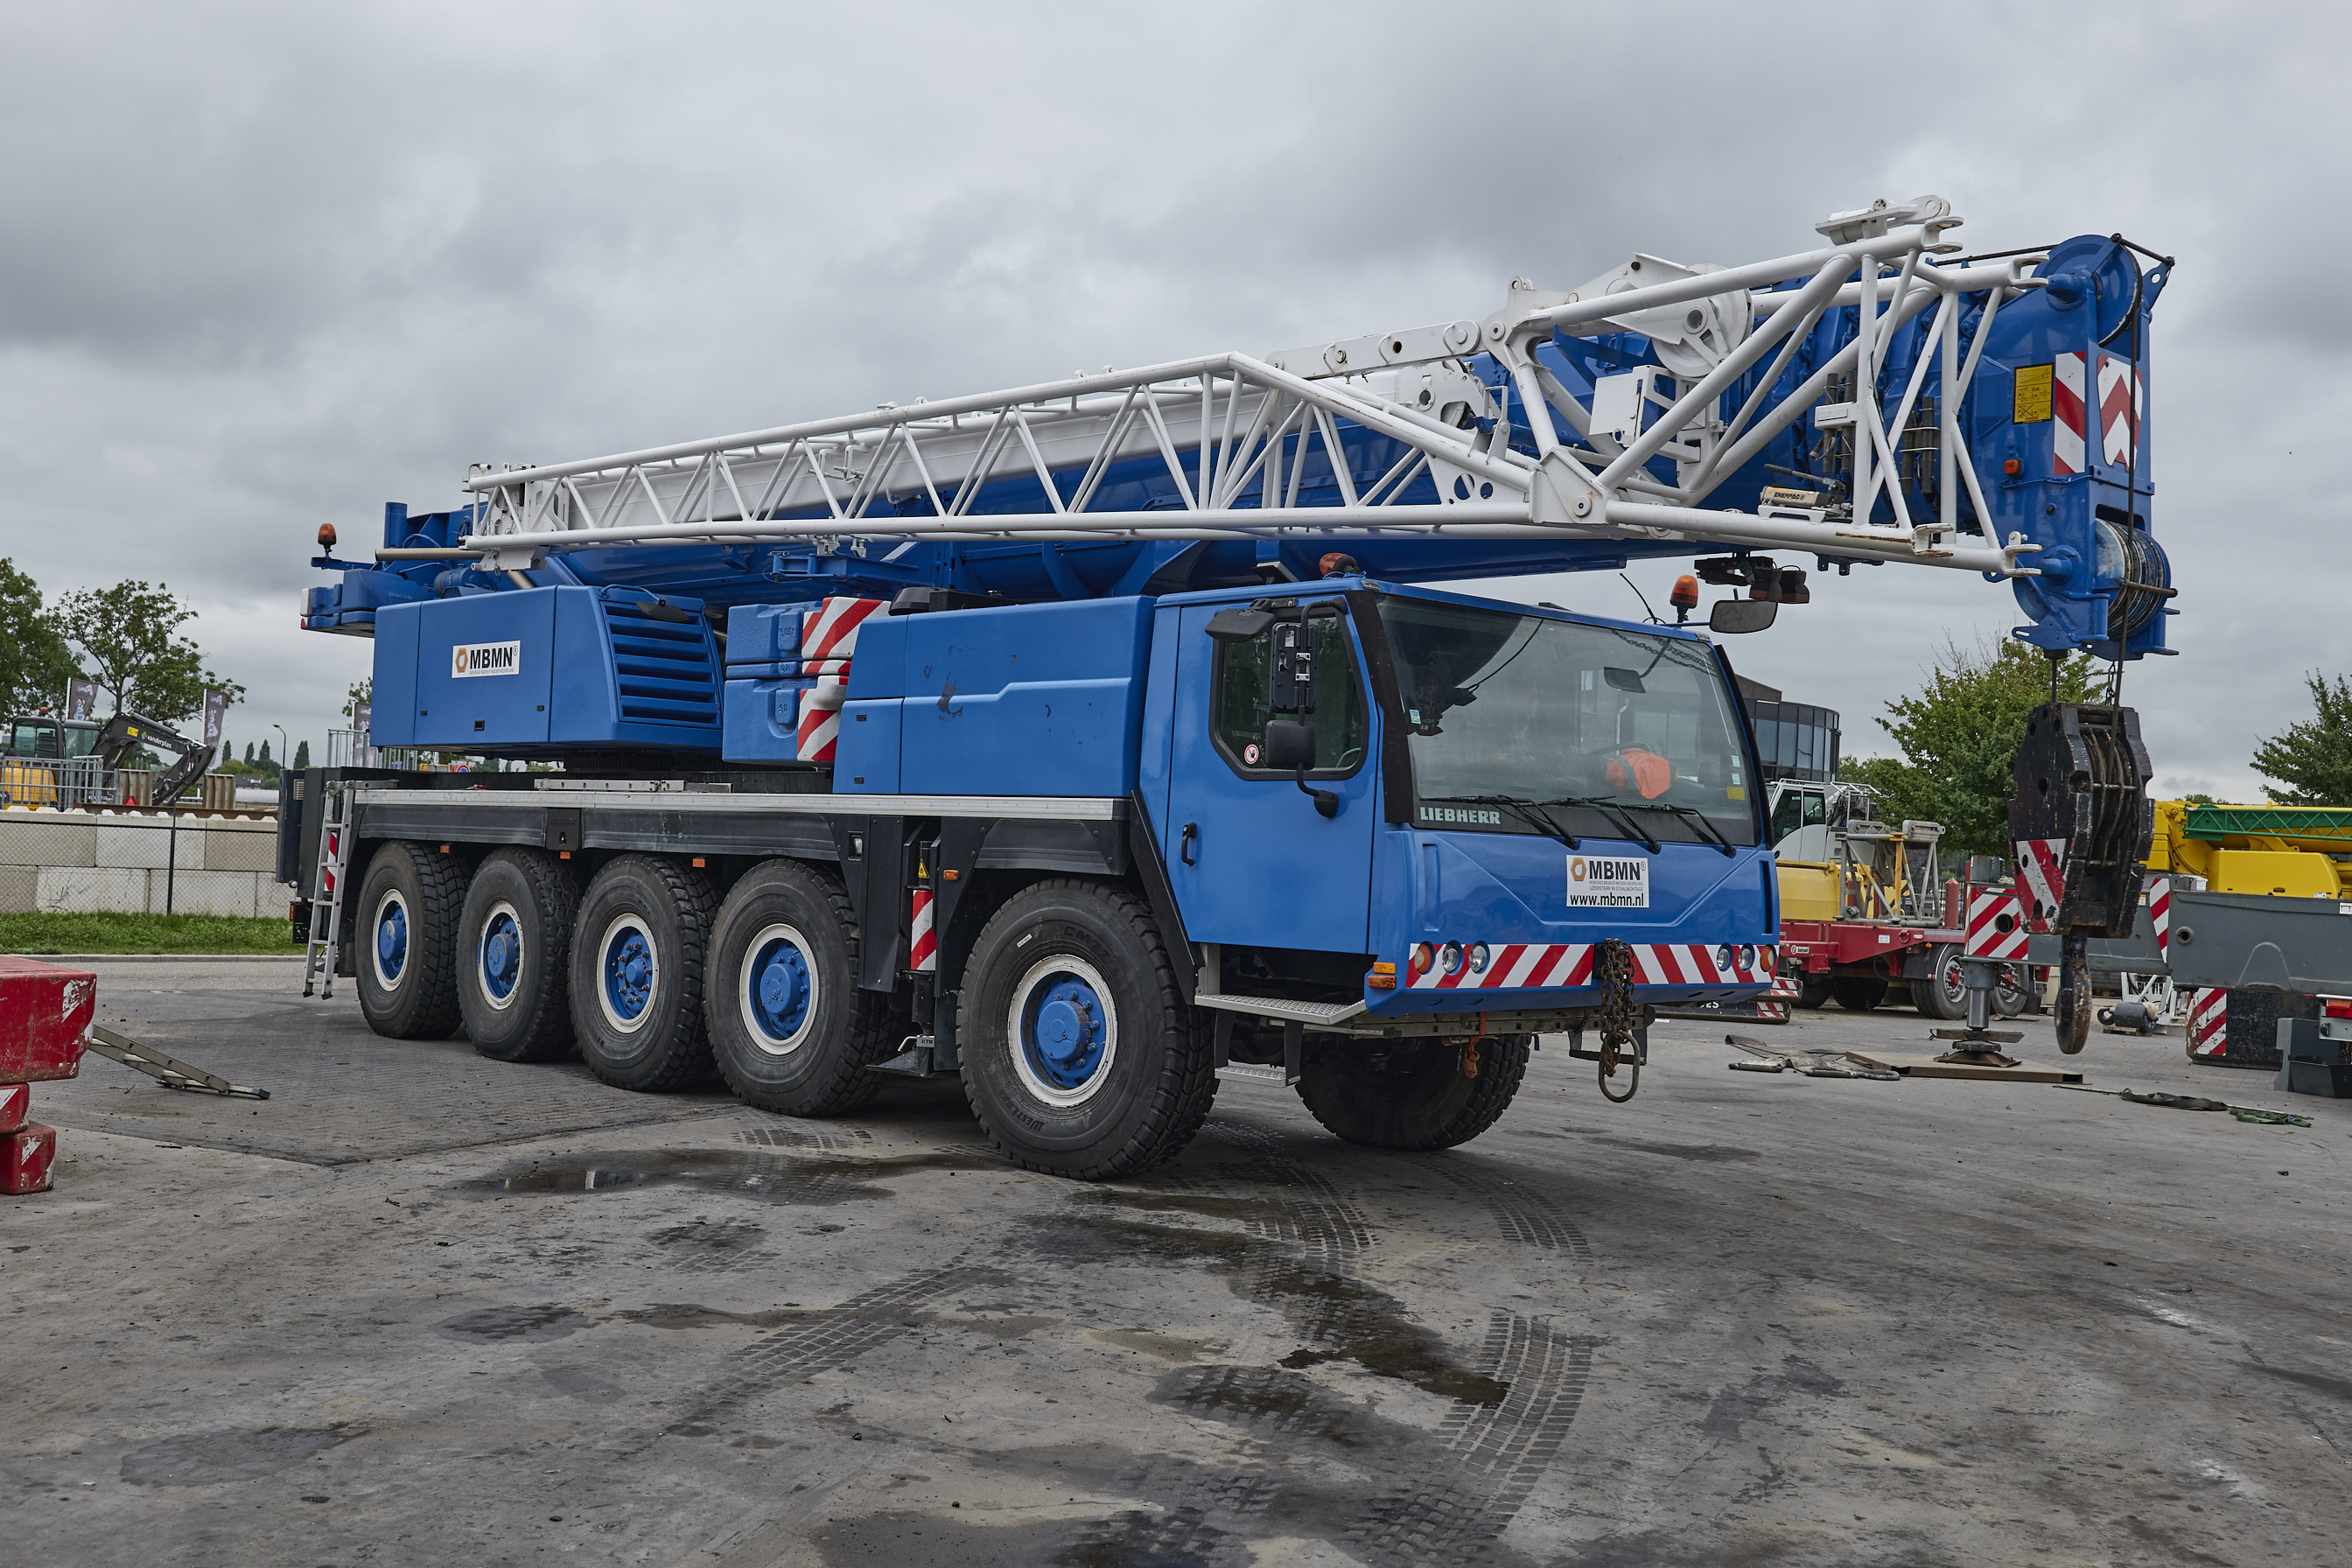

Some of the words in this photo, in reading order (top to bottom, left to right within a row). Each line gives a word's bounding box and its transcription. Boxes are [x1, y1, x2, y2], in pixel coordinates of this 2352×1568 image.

[470, 647, 513, 669] MBMN
[147, 735, 172, 749] vanderplas
[1420, 807, 1501, 824] LIEBHERR
[1589, 860, 1641, 880] MBMN
[1570, 892, 1644, 906] www.mbmn.nl
